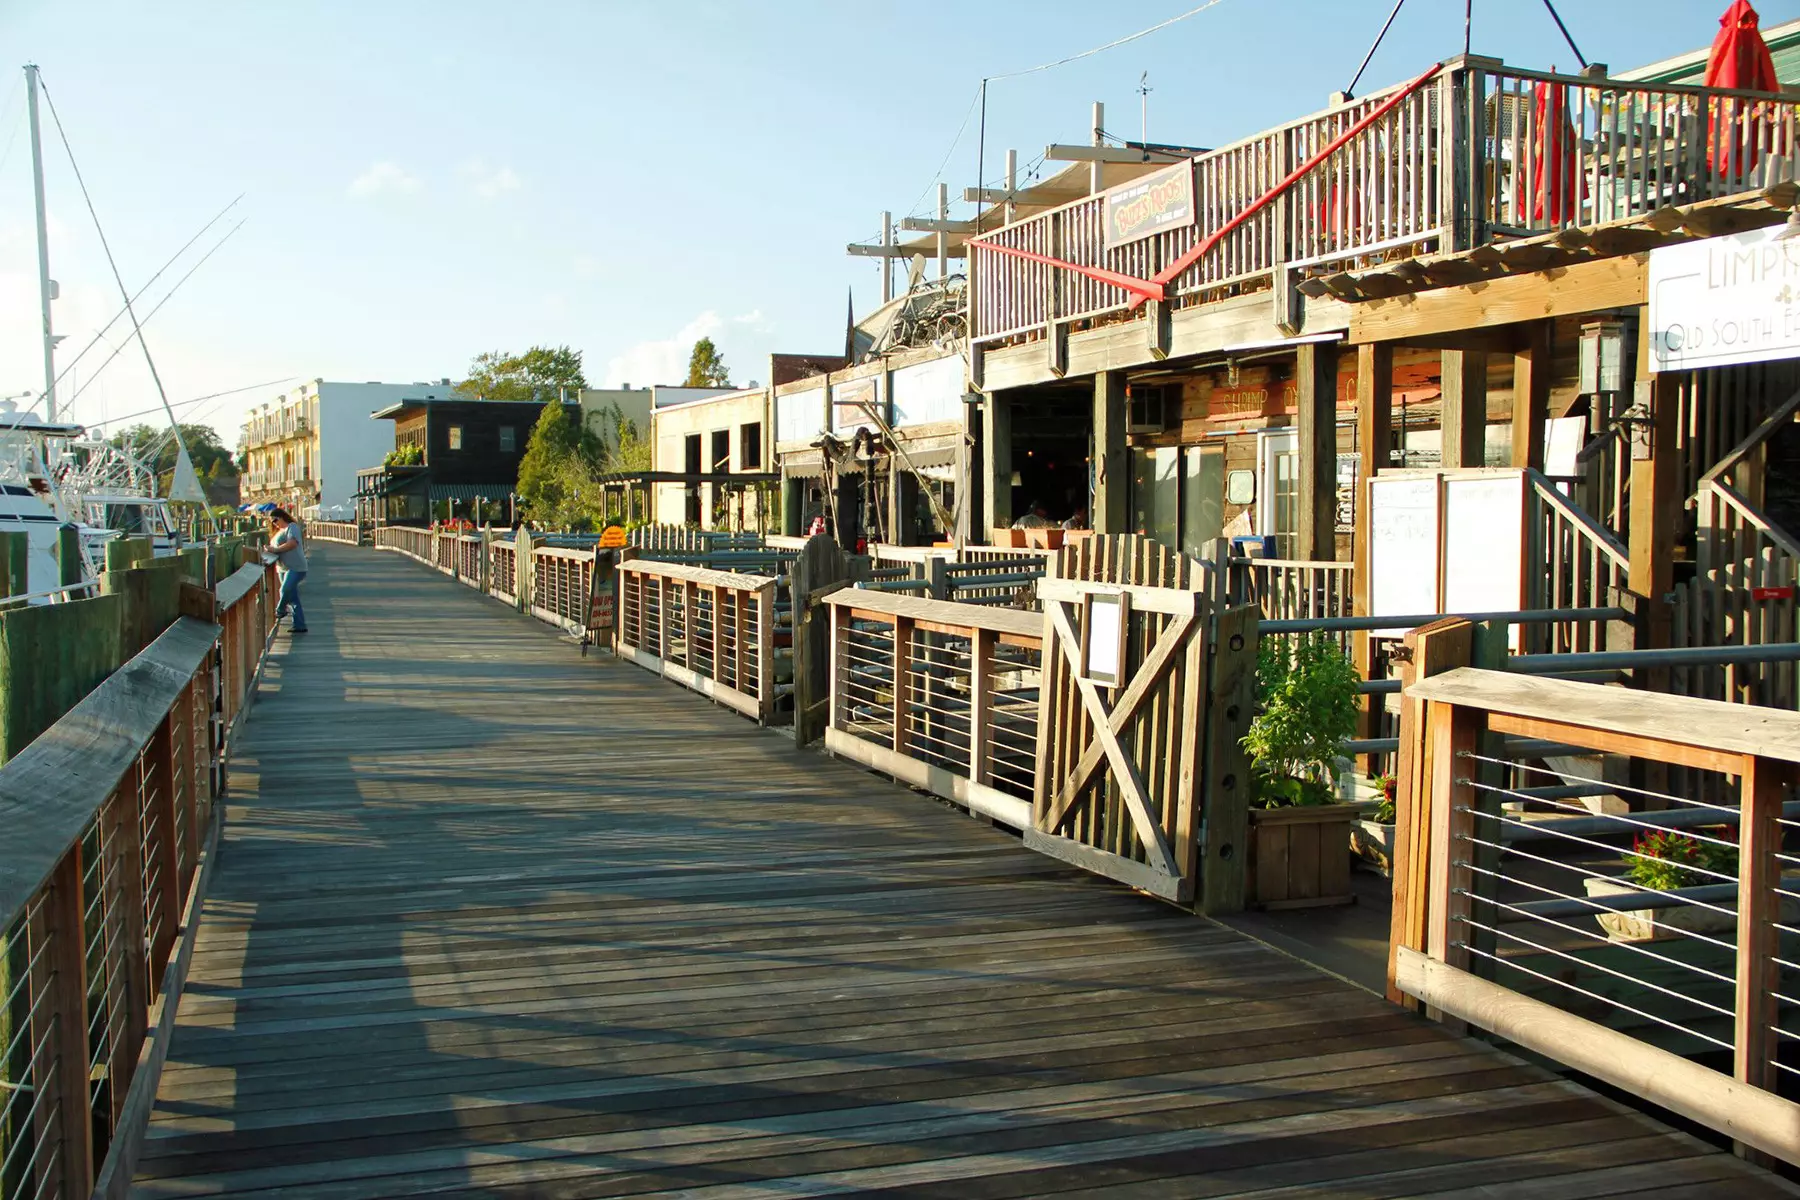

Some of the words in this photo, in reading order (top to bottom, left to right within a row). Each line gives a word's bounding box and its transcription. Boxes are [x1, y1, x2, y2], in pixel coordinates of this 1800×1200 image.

[1150, 168, 1188, 215] ROOST
[1665, 323, 1703, 352] OLD
[1712, 315, 1773, 346] SOUTH
[1223, 388, 1268, 415] SHRIMP
